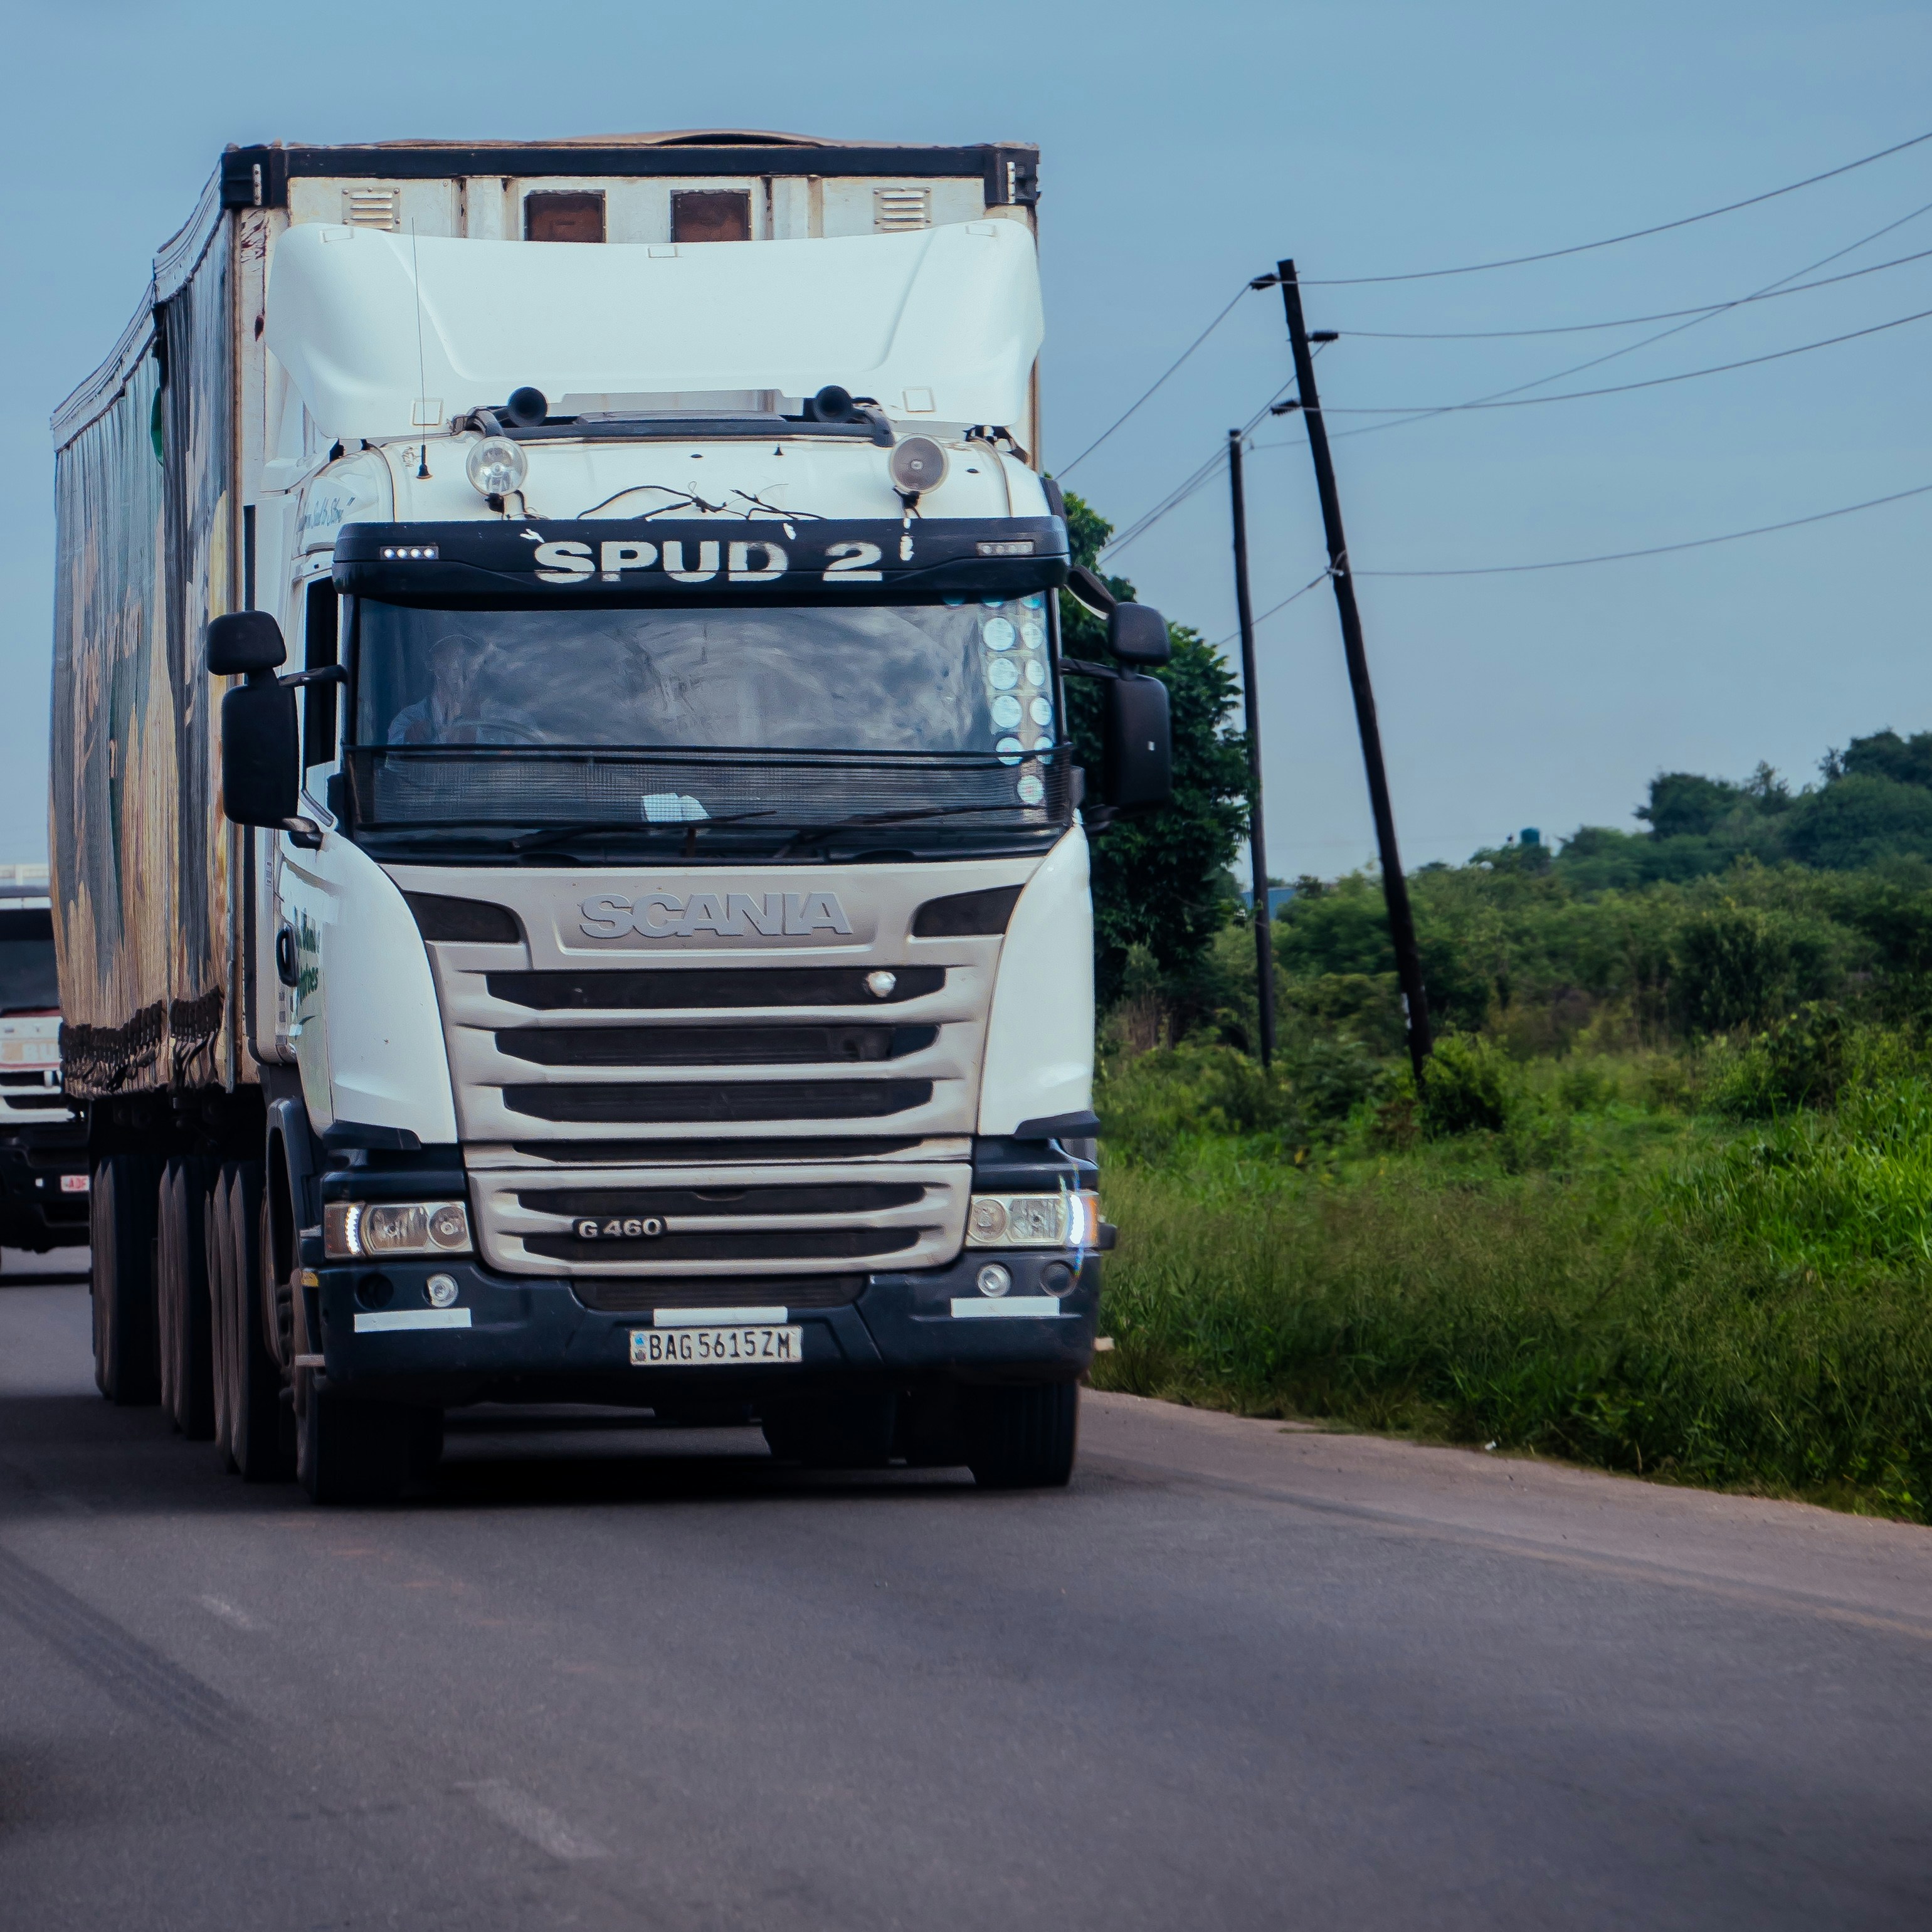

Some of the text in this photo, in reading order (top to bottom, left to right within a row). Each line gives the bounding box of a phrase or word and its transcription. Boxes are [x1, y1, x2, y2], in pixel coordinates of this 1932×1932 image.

[534, 540, 883, 584] SPUD 2
[579, 892, 854, 939] SCANIA
[579, 1218, 663, 1238] G 460
